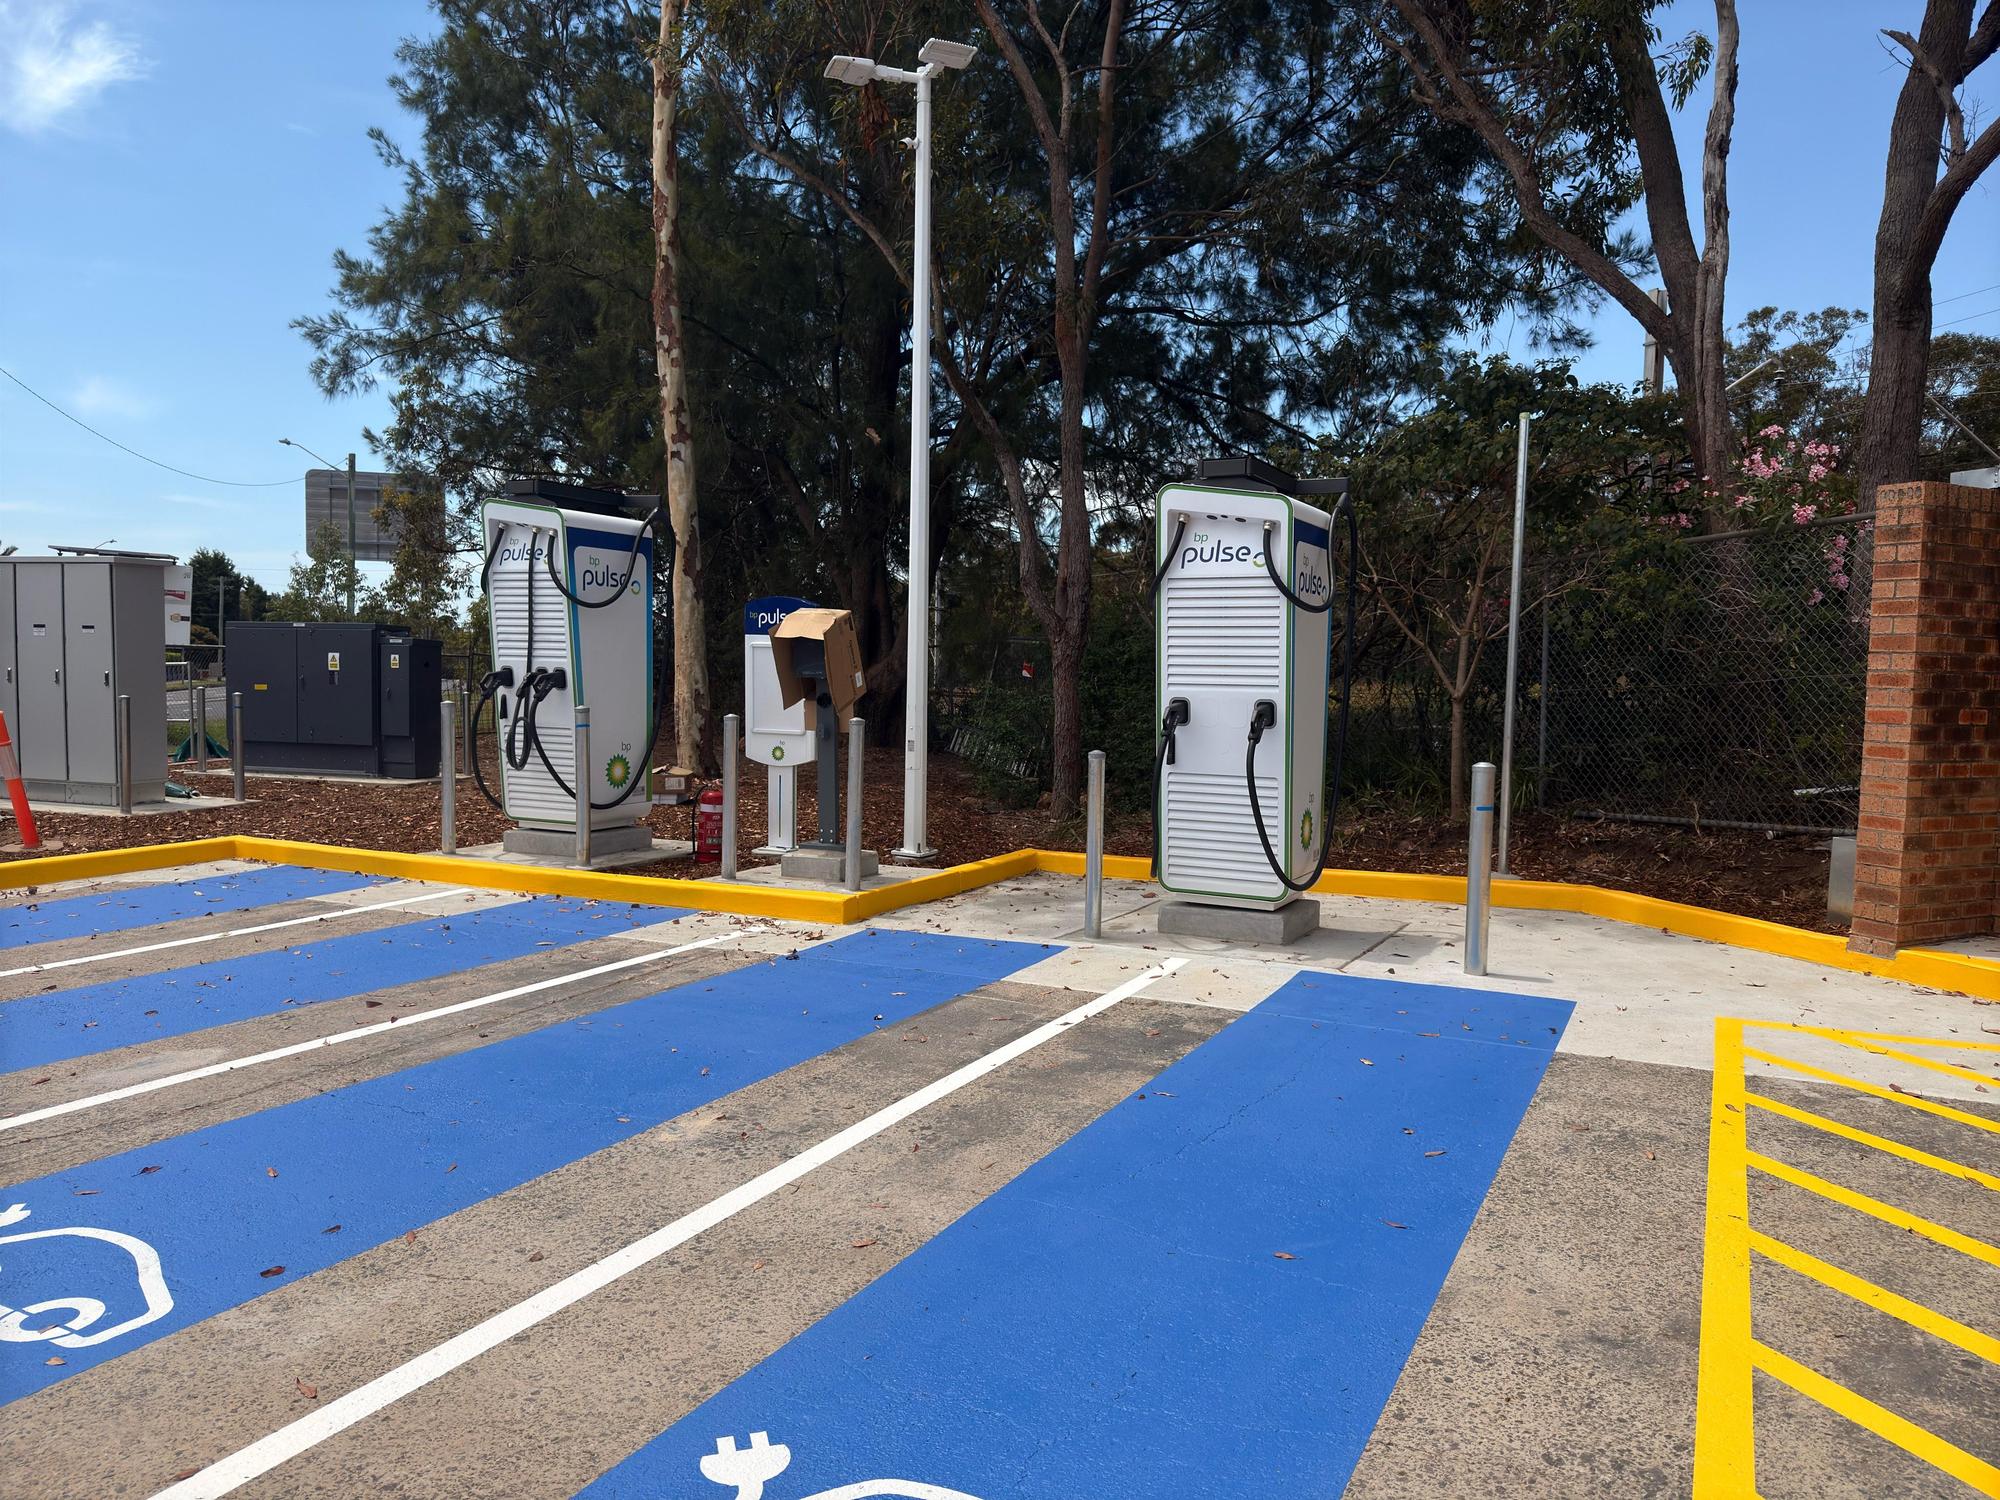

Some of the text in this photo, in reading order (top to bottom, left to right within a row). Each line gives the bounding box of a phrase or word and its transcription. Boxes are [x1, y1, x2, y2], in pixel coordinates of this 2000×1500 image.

[509, 537, 519, 547] bp
[1194, 532, 1208, 544] bp
[499, 543, 544, 566] pulse
[589, 554, 600, 567] bp
[1181, 540, 1251, 569] pulse
[1299, 566, 1322, 600] pulse
[758, 608, 786, 628] puls
[621, 741, 631, 752] bp
